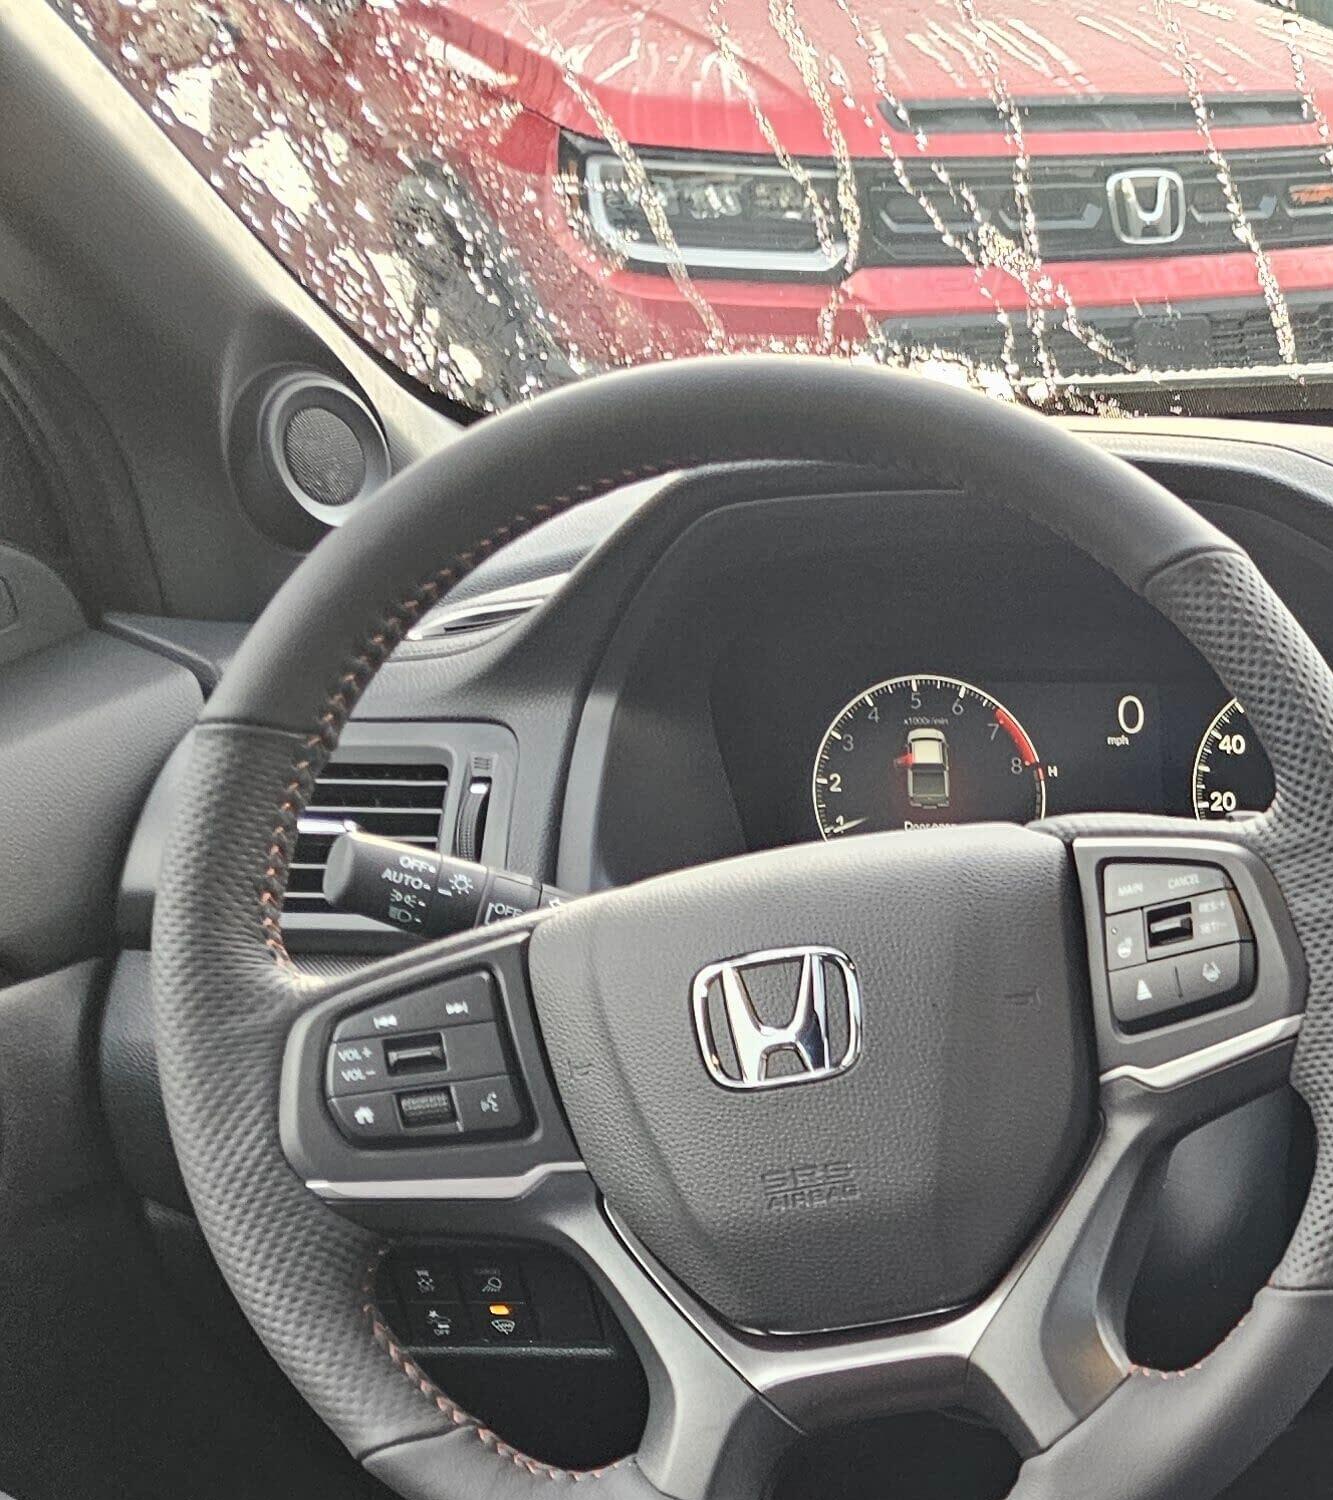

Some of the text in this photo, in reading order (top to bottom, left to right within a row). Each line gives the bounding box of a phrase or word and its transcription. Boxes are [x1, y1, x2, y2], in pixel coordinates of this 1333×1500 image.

[910, 693, 921, 709] 5
[952, 699, 964, 715] 6
[868, 708, 880, 722] 4
[1117, 695, 1145, 734] 0
[987, 723, 999, 740] 7
[842, 736, 854, 751] 3
[1107, 736, 1130, 747] mph
[1218, 735, 1246, 754] 40
[1011, 758, 1022, 774] 8
[829, 774, 842, 793] 2
[1210, 791, 1237, 811] 20
[400, 855, 430, 871] OFF
[382, 868, 423, 889] AUTO
